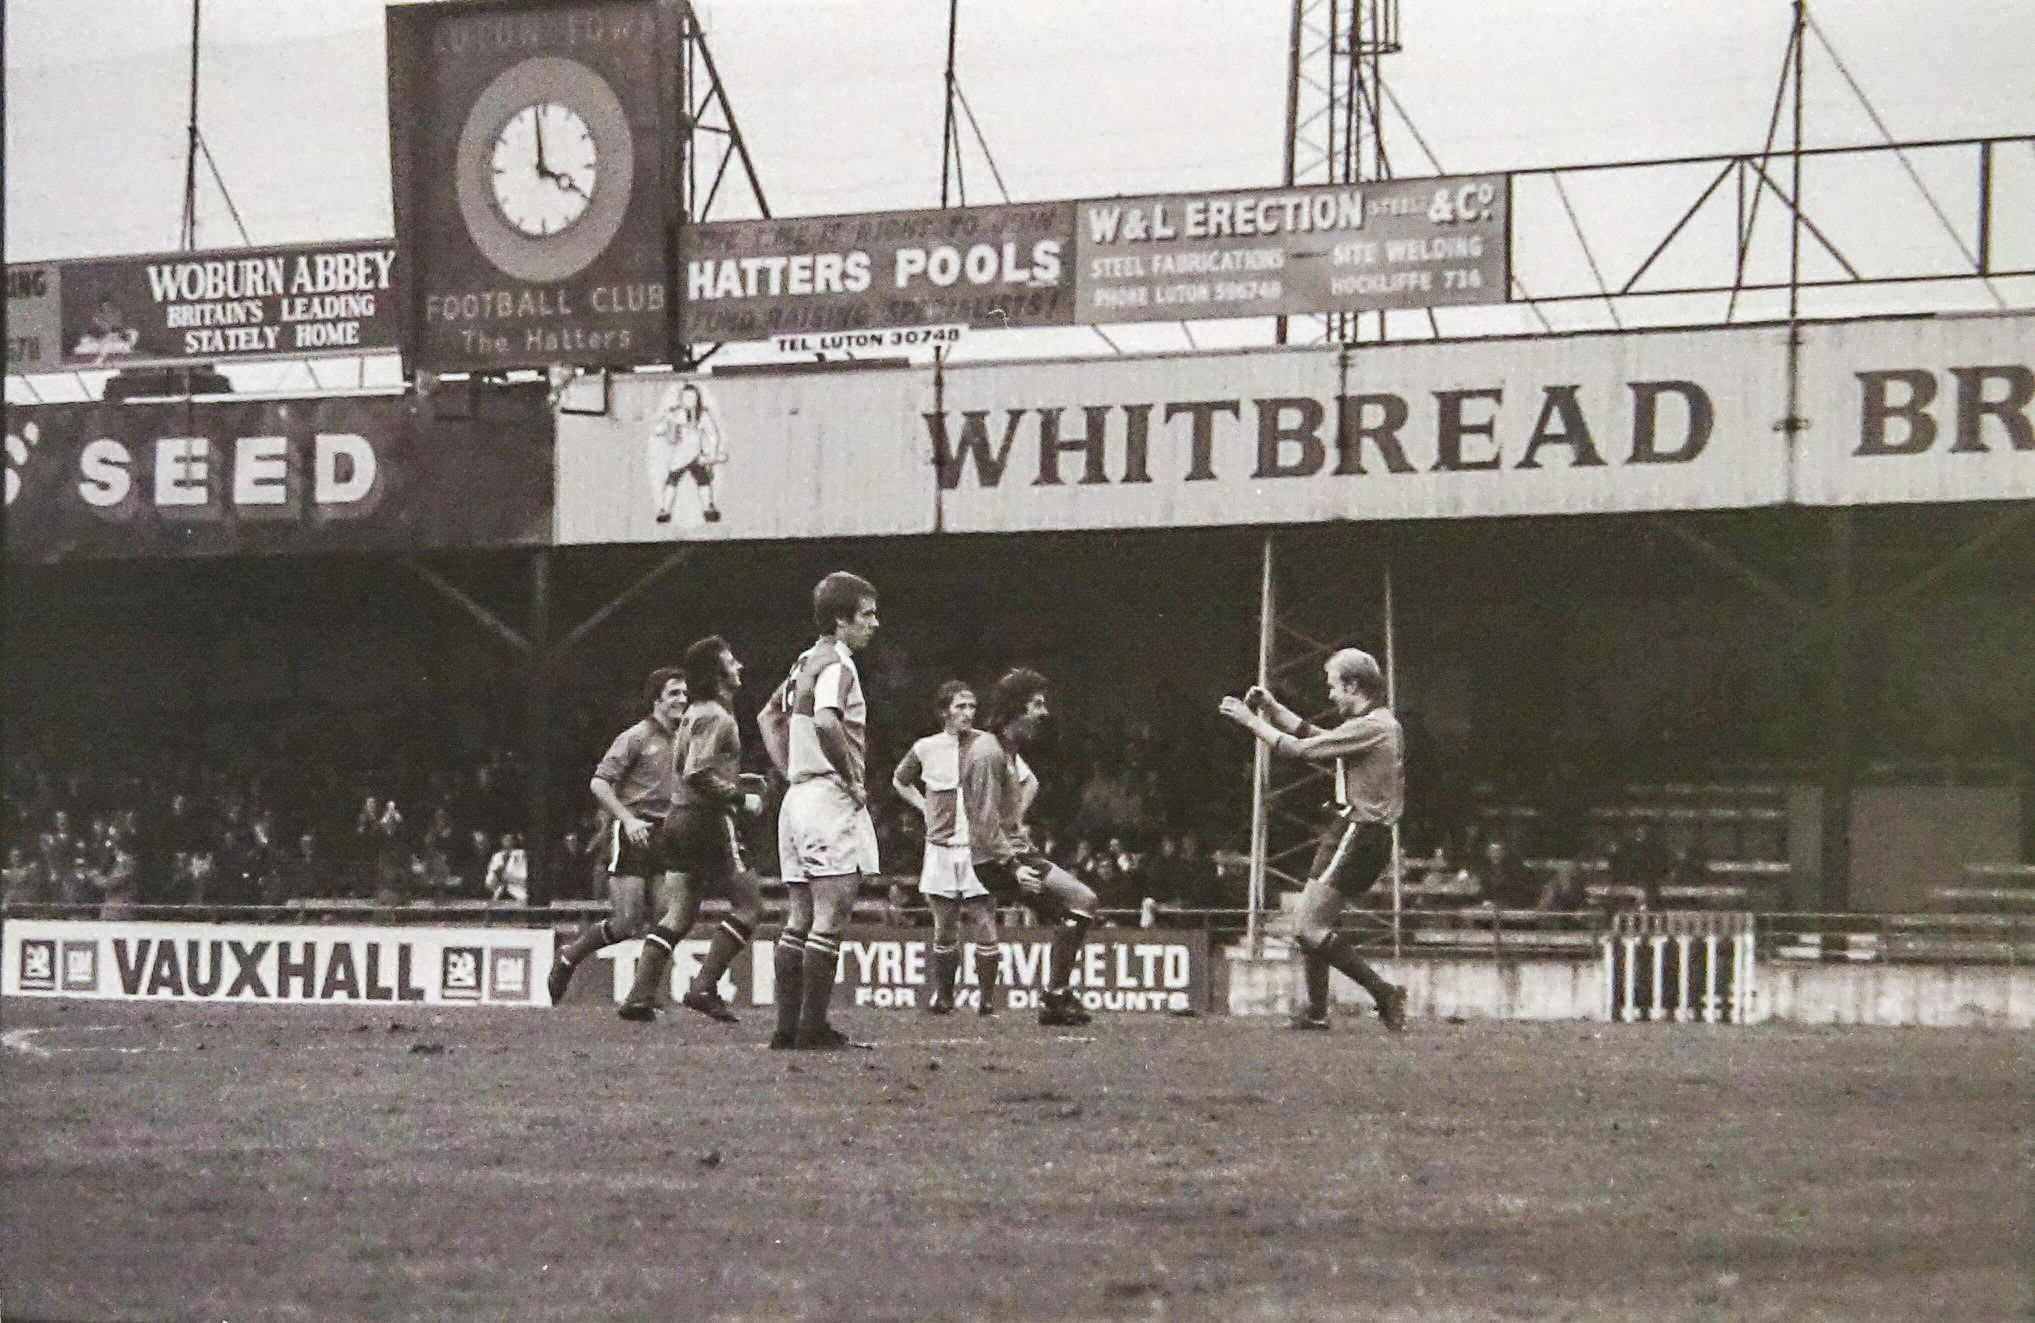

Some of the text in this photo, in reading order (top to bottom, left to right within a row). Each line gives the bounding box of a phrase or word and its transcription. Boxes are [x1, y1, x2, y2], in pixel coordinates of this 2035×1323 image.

[1186, 191, 1364, 239] ERECTION
[147, 250, 396, 303] WOBURN ABBEY
[687, 239, 1063, 301] HATTERS POOLS
[1090, 256, 1145, 280] STEEL
[1152, 248, 1286, 274] FABRICATIONS
[1385, 234, 1484, 263] WELDING
[281, 294, 375, 322] LEADING
[426, 283, 664, 321] FOOTBALL CLUB
[185, 321, 361, 354] STATELY HOME
[461, 327, 631, 354] The Hatters
[820, 333, 883, 350] LUTON
[921, 379, 1716, 490] WHITBREAD
[78, 432, 377, 507] SEED
[112, 938, 425, 1001] VAUXHALL
[834, 940, 926, 984] TYRE
[1115, 942, 1190, 988] LTD
[855, 987, 916, 1008] FOR
